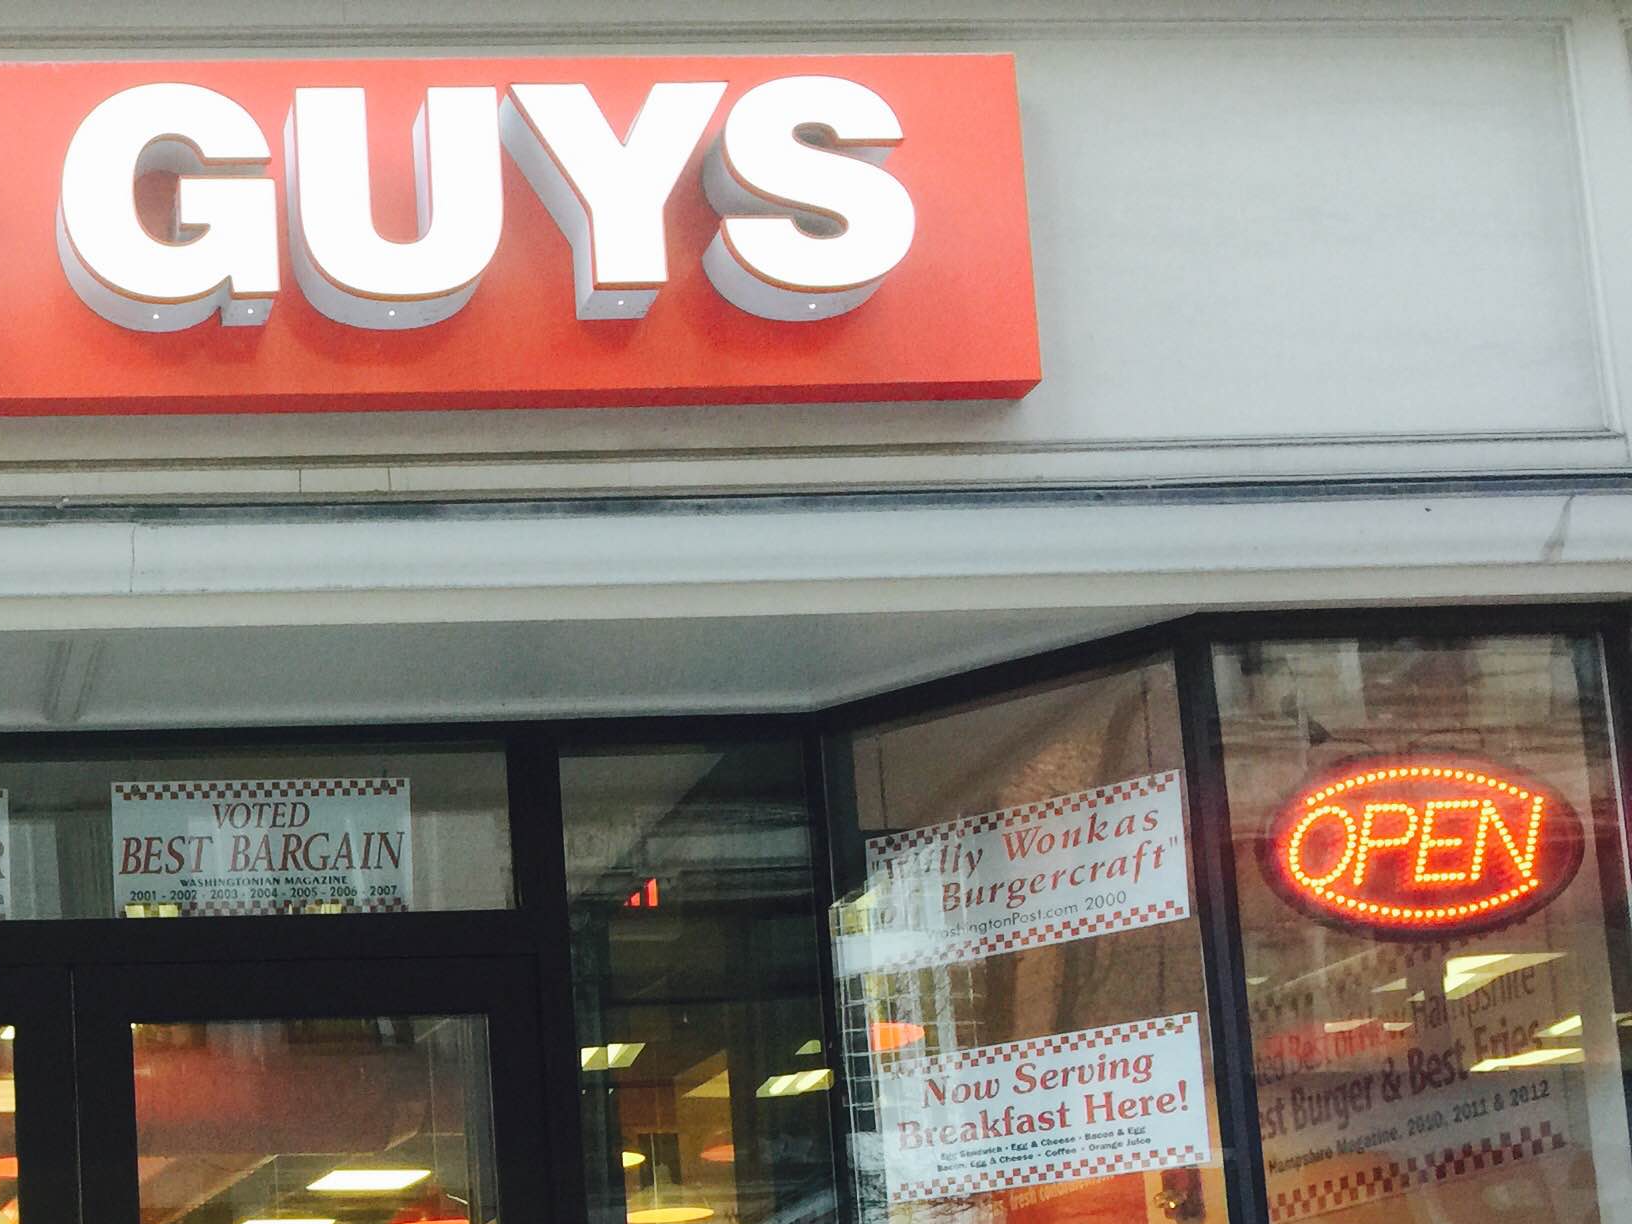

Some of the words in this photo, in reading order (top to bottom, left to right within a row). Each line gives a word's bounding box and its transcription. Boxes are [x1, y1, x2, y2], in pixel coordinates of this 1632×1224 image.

[59, 77, 916, 331] GUYS
[212, 801, 310, 829] VOTED
[1001, 806, 1160, 864] Wonkas
[1286, 795, 1545, 887] OPEN
[119, 835, 214, 875] BEST
[228, 831, 406, 873] BARGAIN
[941, 836, 1179, 914] Burgercraft"
[129, 889, 157, 901] 2001
[169, 889, 198, 900] 2002
[209, 888, 239, 899] 2003
[249, 887, 278, 899] 2004
[289, 887, 318, 898] 2005
[329, 885, 358, 897] 2006
[369, 884, 398, 897] 2007
[179, 876, 279, 888] WASHINGTONIAN
[284, 874, 348, 886] MAGAZINE
[928, 905, 1079, 942] ashingtonPost.com
[1084, 889, 1128, 910] 2000
[921, 1073, 1001, 1110] Now
[1011, 1052, 1155, 1096] Serving
[1290, 1072, 1374, 1133] Burger
[1407, 1039, 1470, 1096] Best
[1508, 1078, 1551, 1108] 2012
[896, 1101, 1072, 1152] Breakfast
[1082, 1079, 1189, 1126] Here!
[1040, 1136, 1076, 1147] Cheese
